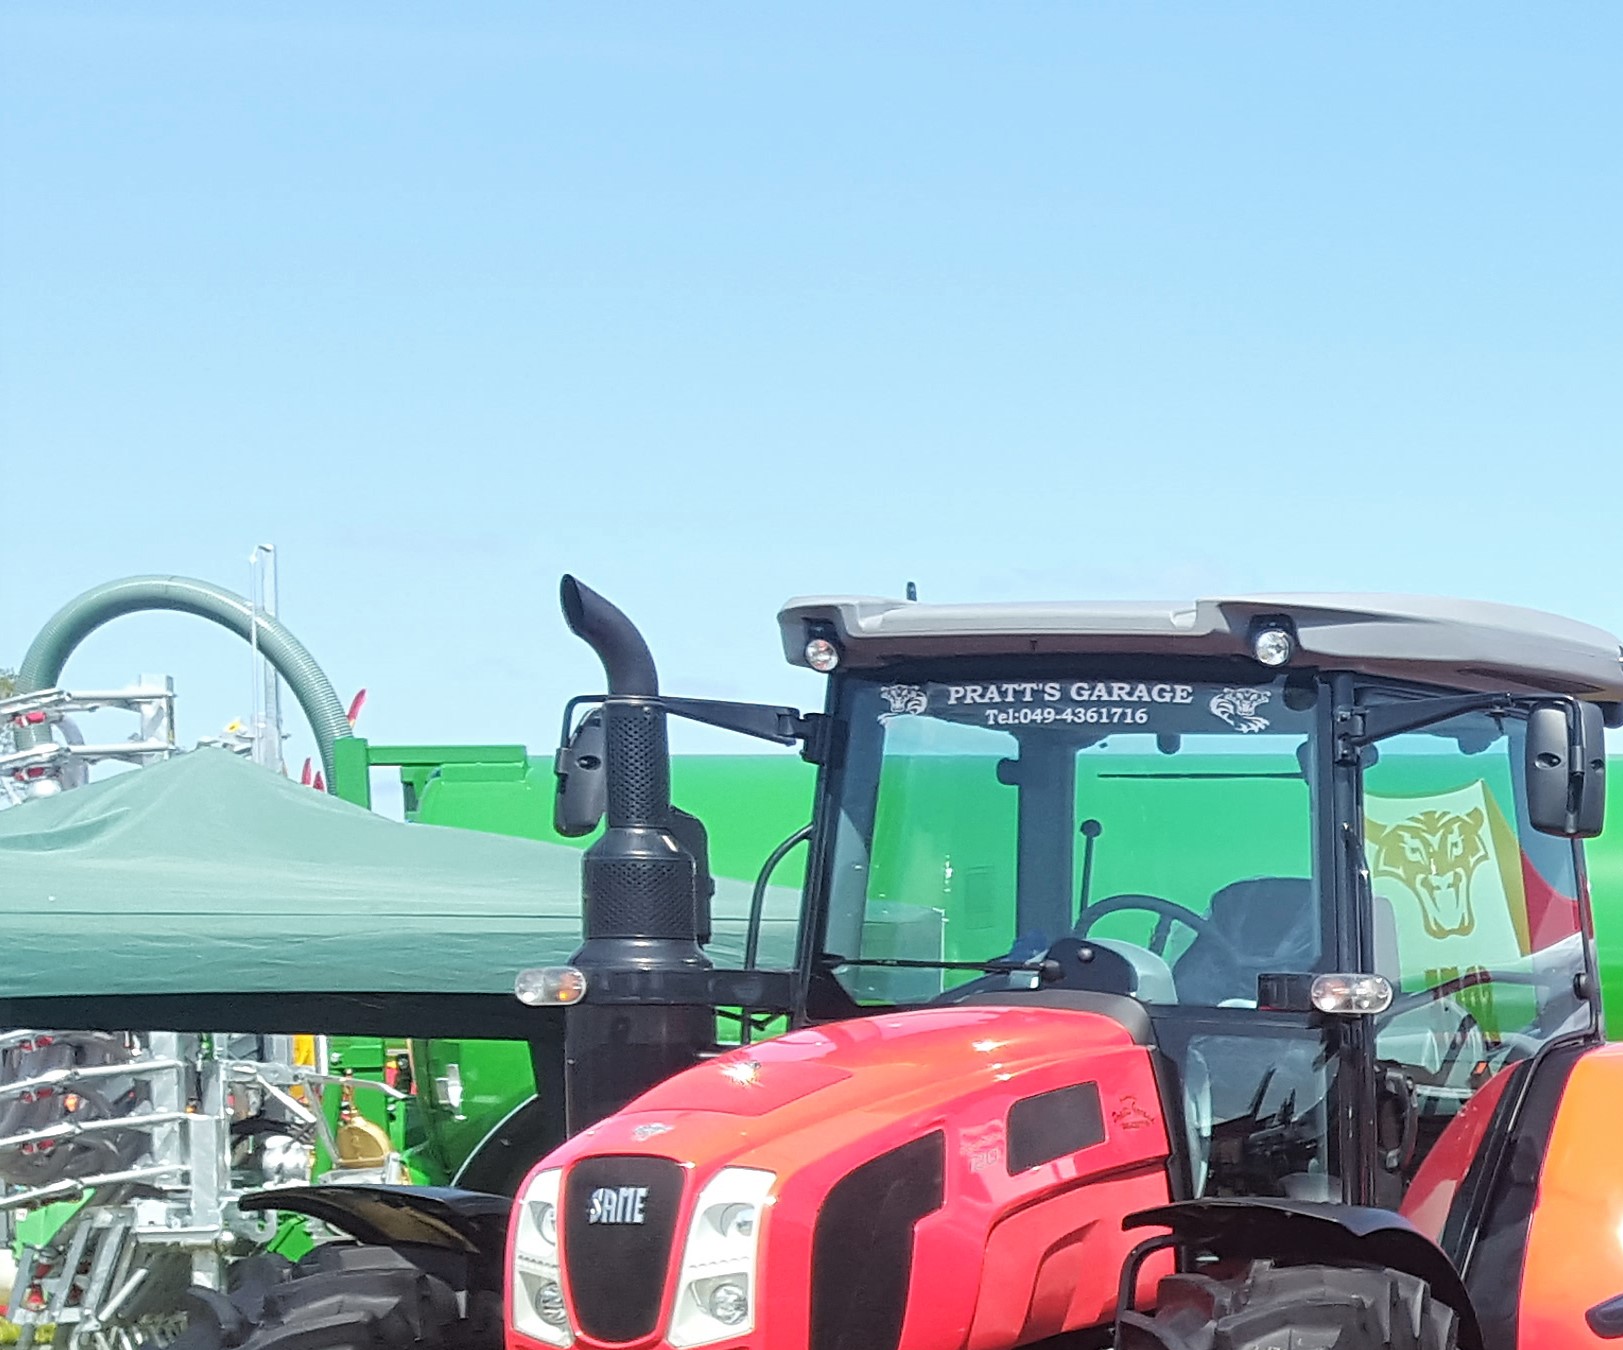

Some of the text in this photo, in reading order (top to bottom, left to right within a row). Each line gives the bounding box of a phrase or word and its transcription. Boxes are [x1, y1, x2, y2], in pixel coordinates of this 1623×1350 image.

[947, 682, 1194, 706] PRATT'S GARAGE
[985, 707, 1149, 726] Tel:049-4361716
[588, 1186, 650, 1224] SAME
